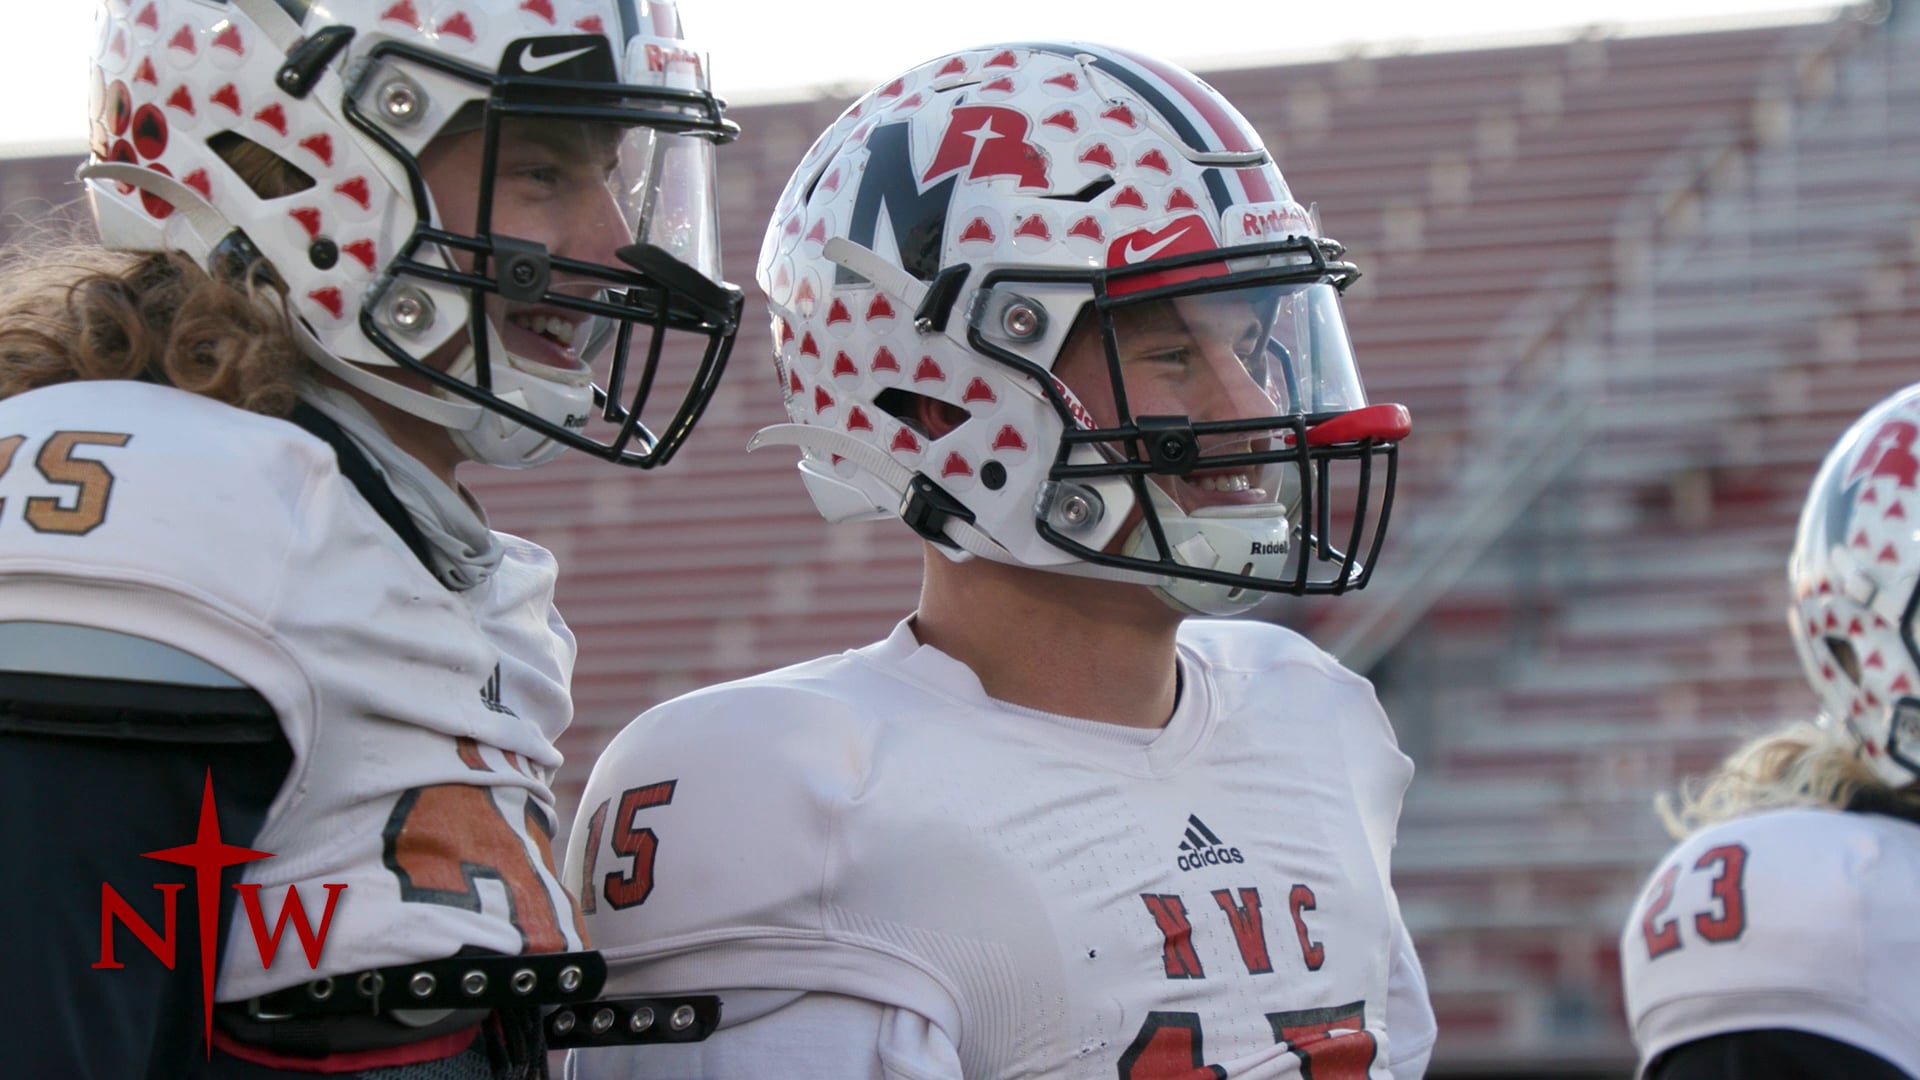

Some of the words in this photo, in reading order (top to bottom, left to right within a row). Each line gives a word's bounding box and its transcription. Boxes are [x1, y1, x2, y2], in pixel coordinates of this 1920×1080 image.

[580, 779, 678, 916] 15
[1177, 845, 1245, 872] adidas
[1642, 843, 1749, 960] 23
